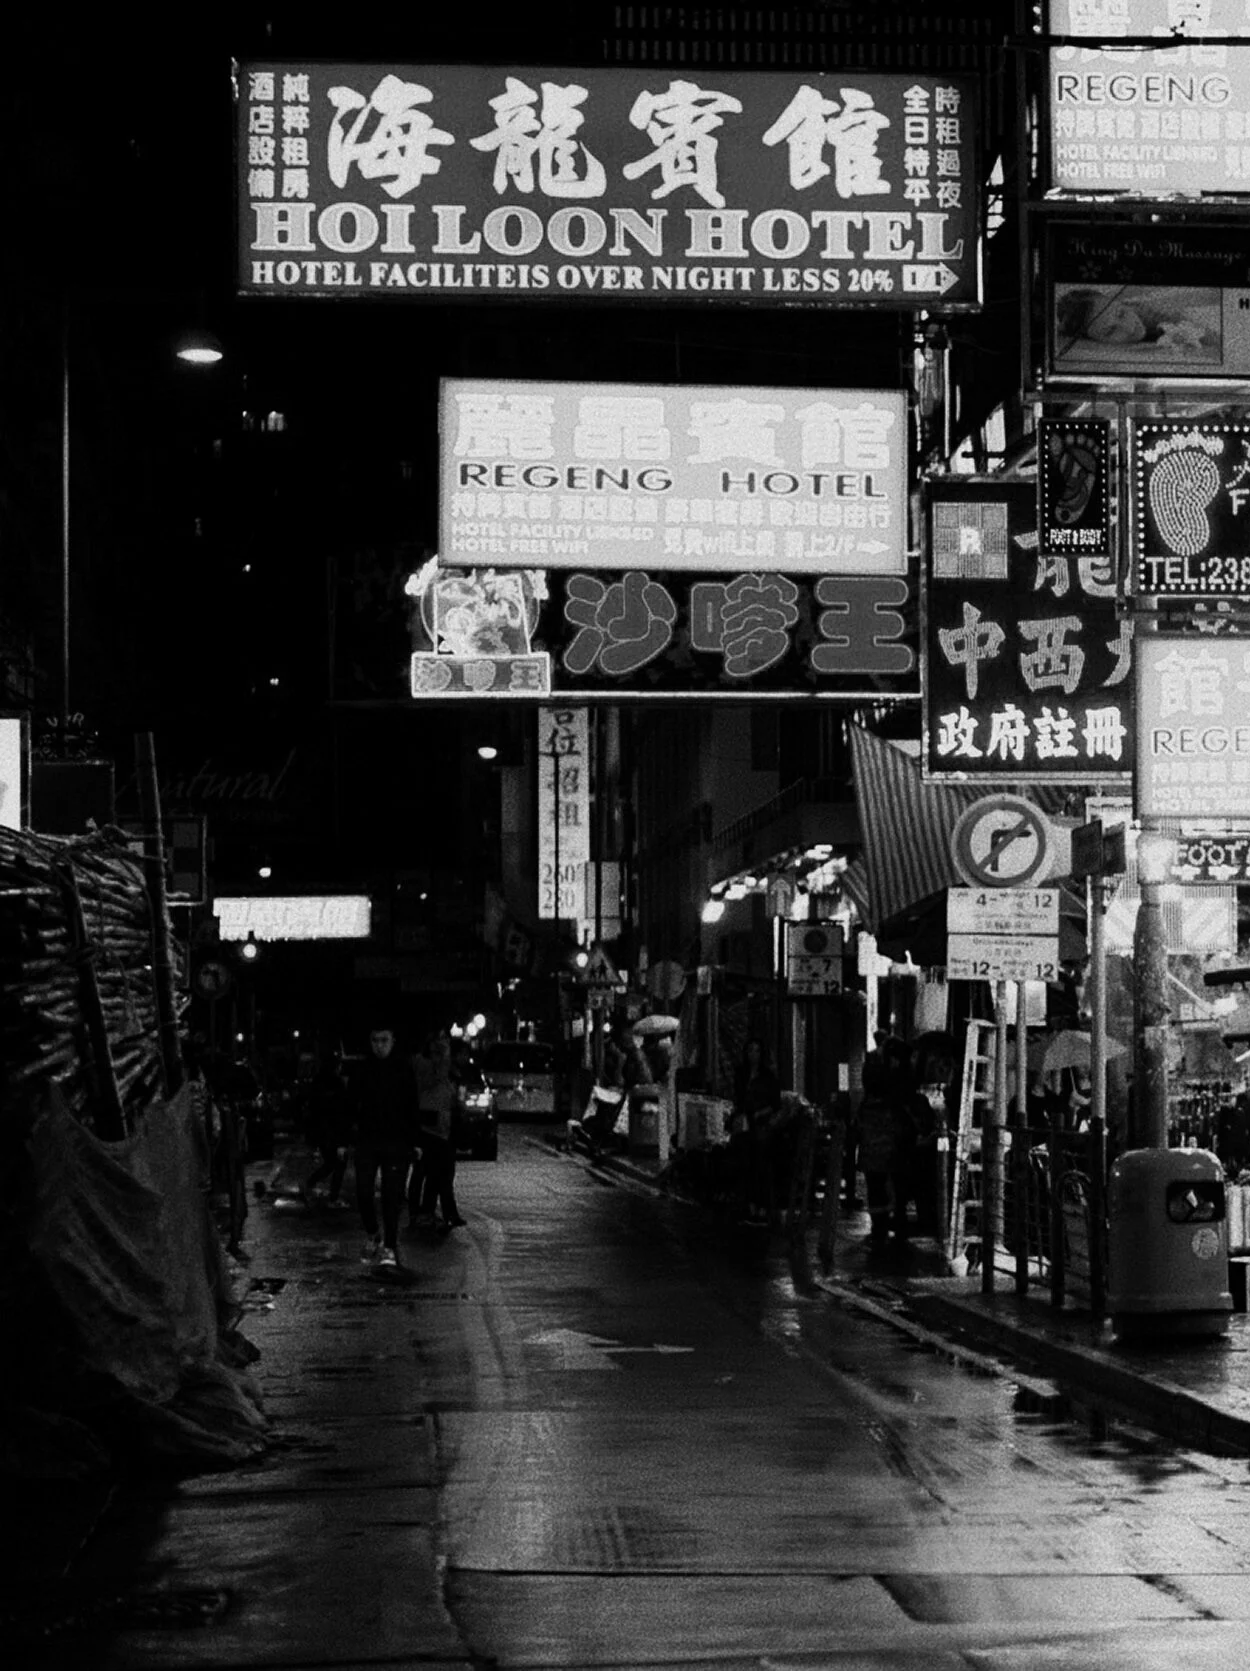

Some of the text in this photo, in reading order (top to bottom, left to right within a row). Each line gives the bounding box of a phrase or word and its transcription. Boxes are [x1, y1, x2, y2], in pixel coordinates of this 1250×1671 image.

[1057, 74, 1230, 104] REGENG
[327, 74, 891, 207] 海龍賓館
[250, 202, 964, 260] HOI LOON HOTEL
[252, 260, 362, 286] HOTEL
[370, 262, 549, 288] FACILITEIS
[555, 265, 646, 289] OVER
[651, 266, 757, 291] NIGHT
[763, 267, 841, 293] LESS
[848, 267, 894, 293] 20%
[458, 462, 888, 499] REGENG HOTEL
[451, 522, 506, 537] HOTEL
[451, 538, 506, 554] HOTEL
[937, 703, 1127, 761] 政府註冊
[1175, 845, 1237, 866] FOOT
[1034, 894, 1053, 908] 12
[1036, 963, 1056, 978] 12
